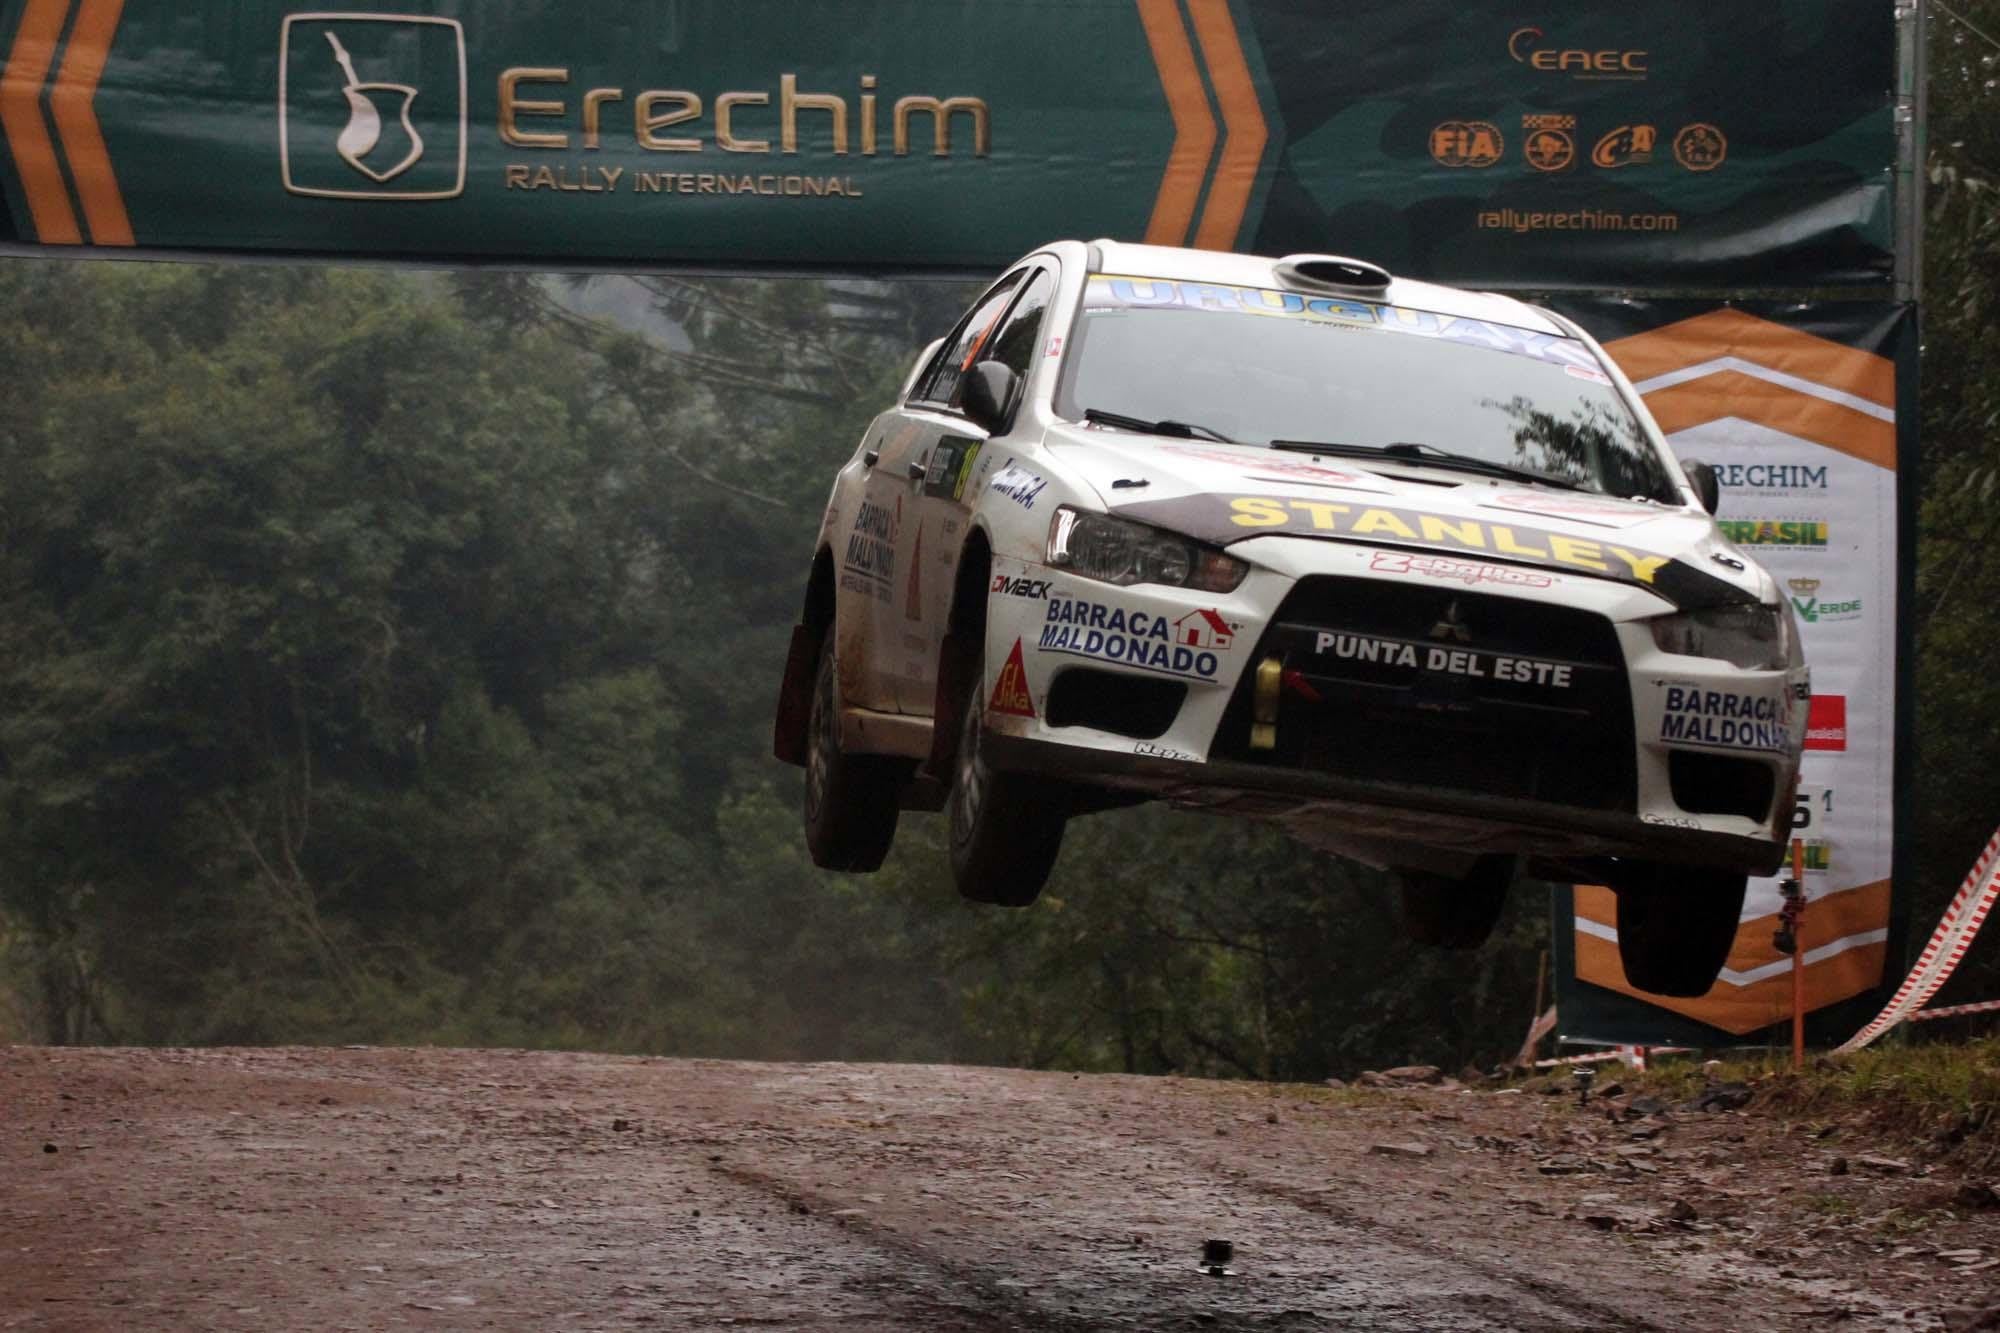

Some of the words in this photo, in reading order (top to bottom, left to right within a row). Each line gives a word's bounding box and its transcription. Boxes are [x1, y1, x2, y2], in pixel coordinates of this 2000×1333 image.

[1531, 50, 1649, 72] EAEC
[498, 66, 991, 158] Erechim
[1432, 128, 1500, 161] FIA
[505, 164, 623, 193] RALLY
[634, 173, 863, 197] INTERNACIONAL
[1477, 208, 1678, 234] rallyerechim.com
[1108, 279, 1562, 355] URUGUAY
[1713, 464, 1828, 488] RECHIM
[1228, 496, 1674, 585] STANLEY
[1046, 598, 1170, 642] BARRACA
[1038, 624, 1219, 678] MALDONADO
[1315, 631, 1418, 669] PUNTA
[1426, 647, 1485, 677] DEL
[1493, 656, 1574, 689] ESTE
[1665, 687, 1778, 722] BARRACA
